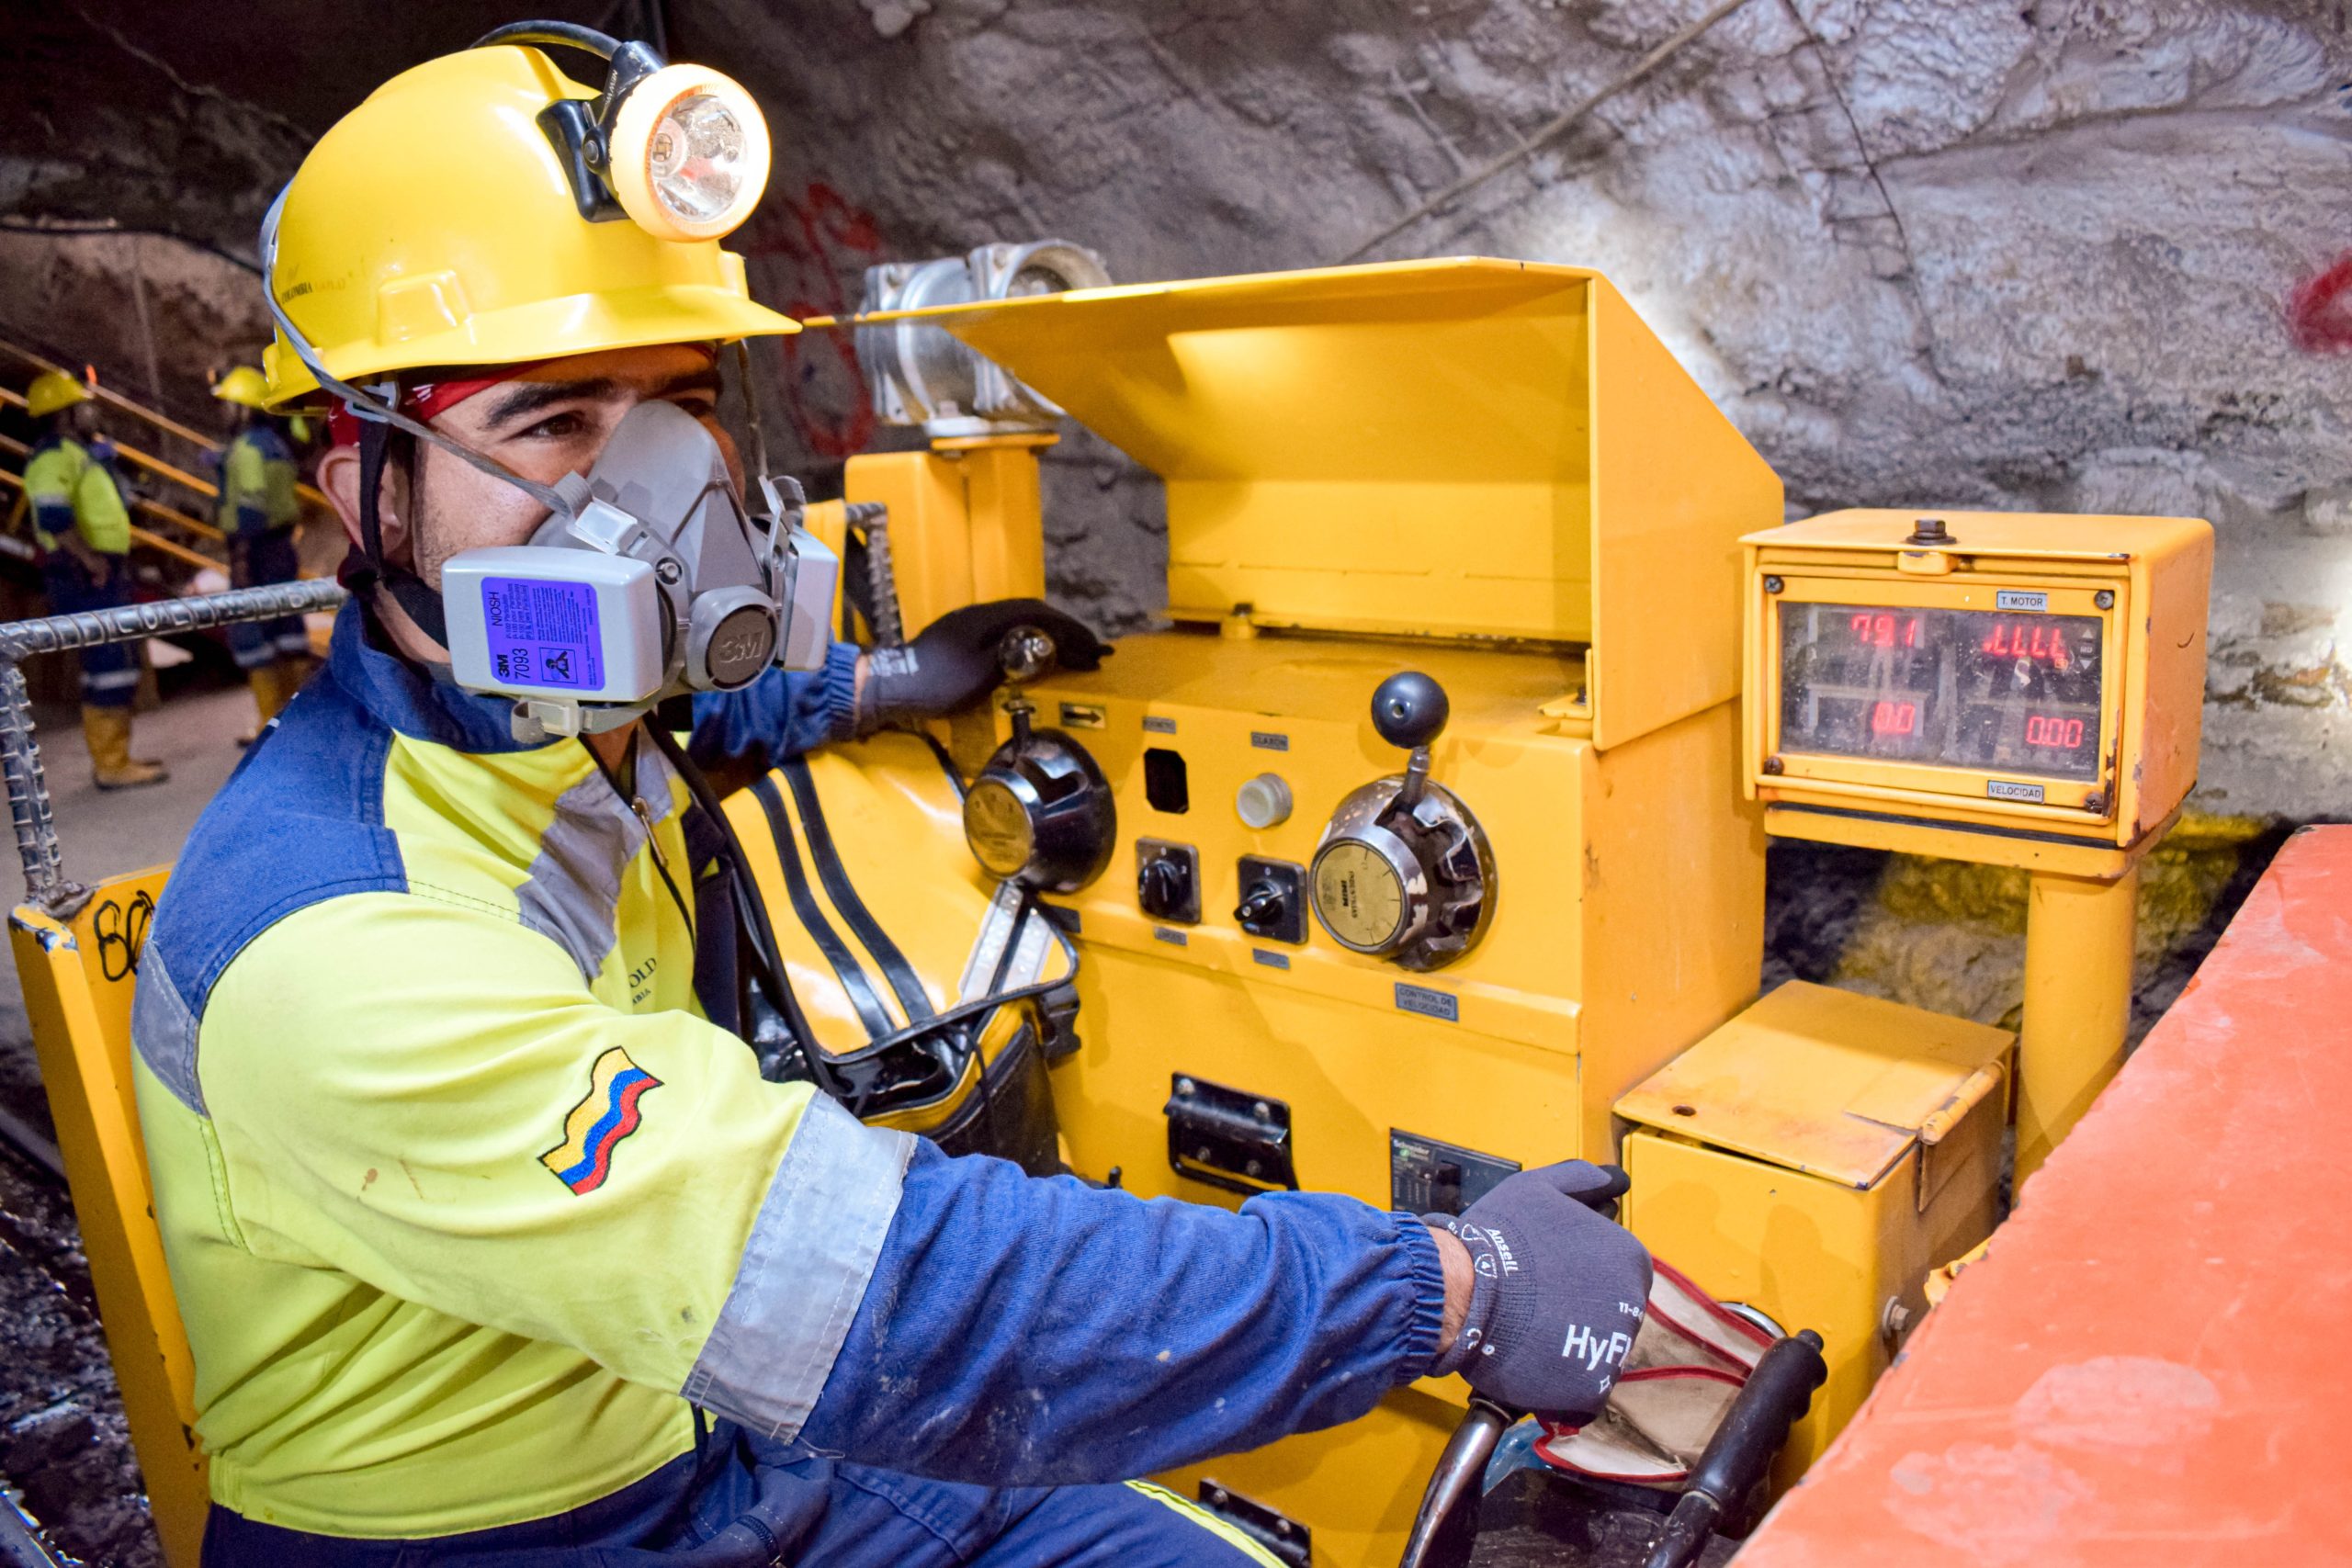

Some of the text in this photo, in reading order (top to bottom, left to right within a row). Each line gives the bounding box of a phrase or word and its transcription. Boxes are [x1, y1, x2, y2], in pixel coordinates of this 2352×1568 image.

[488, 591, 503, 626] NIOSH
[2001, 596, 2043, 606] T. MOTOR
[719, 631, 765, 663] 3M
[496, 653, 511, 678] 3M
[512, 648, 530, 679] 7093
[1990, 784, 2041, 797] VELOCIDAD
[628, 957, 657, 988] OLD
[1398, 987, 1453, 1007] CONTROL DE
[1487, 1228, 1520, 1271] Ansell
[1562, 1324, 1633, 1371] HyFl
